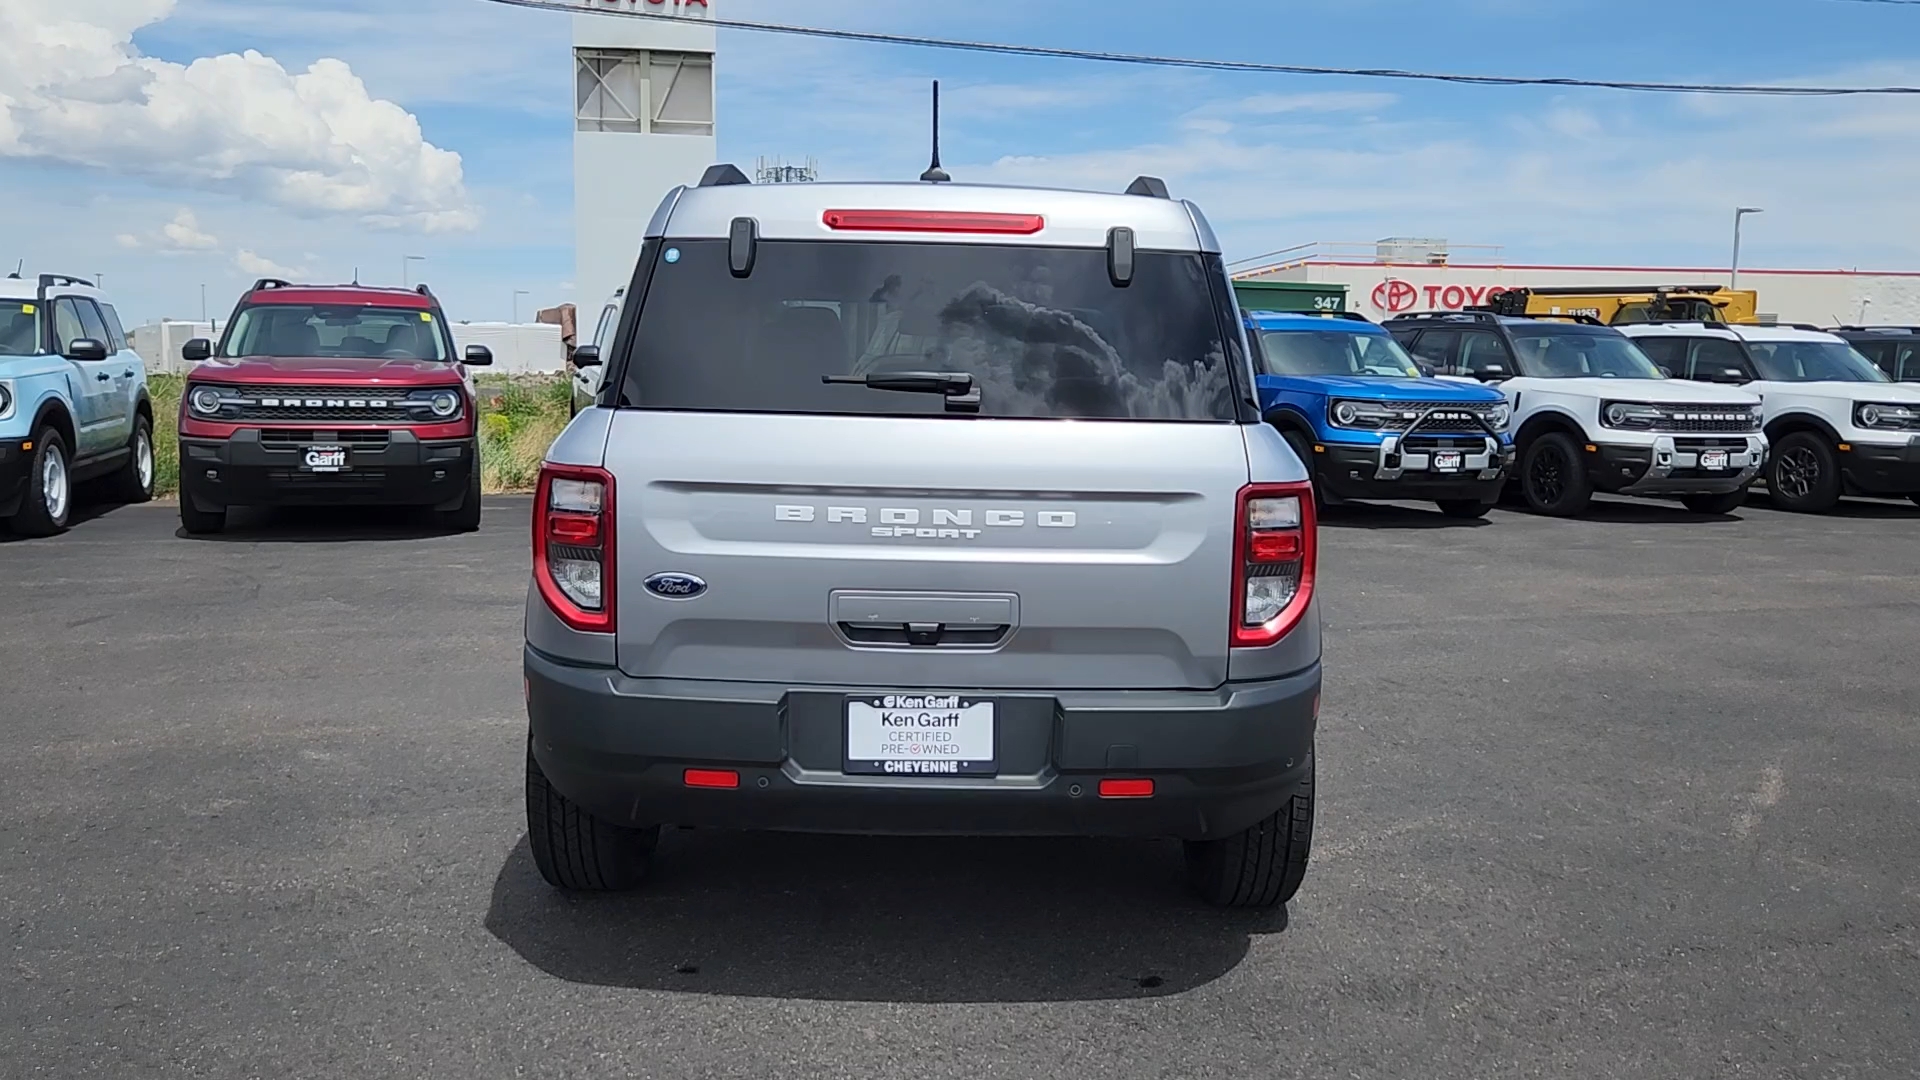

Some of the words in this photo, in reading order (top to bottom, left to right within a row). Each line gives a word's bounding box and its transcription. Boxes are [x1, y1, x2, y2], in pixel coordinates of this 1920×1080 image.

[1313, 296, 1341, 310] 347
[1423, 285, 1522, 310] TOYO
[261, 399, 388, 407] BRONCO
[305, 451, 345, 466] Garff
[1434, 455, 1461, 468] Garff
[1700, 453, 1728, 467] Garff
[774, 504, 1077, 528] BRONCO
[871, 526, 982, 539] SPORT
[657, 577, 692, 593] Ford
[896, 695, 923, 708] Ken
[924, 695, 960, 708] Garff
[881, 711, 915, 727] Ken
[917, 712, 960, 727] Garff
[888, 731, 953, 742] CERTIFIED
[884, 760, 958, 773] CHEYENNE
